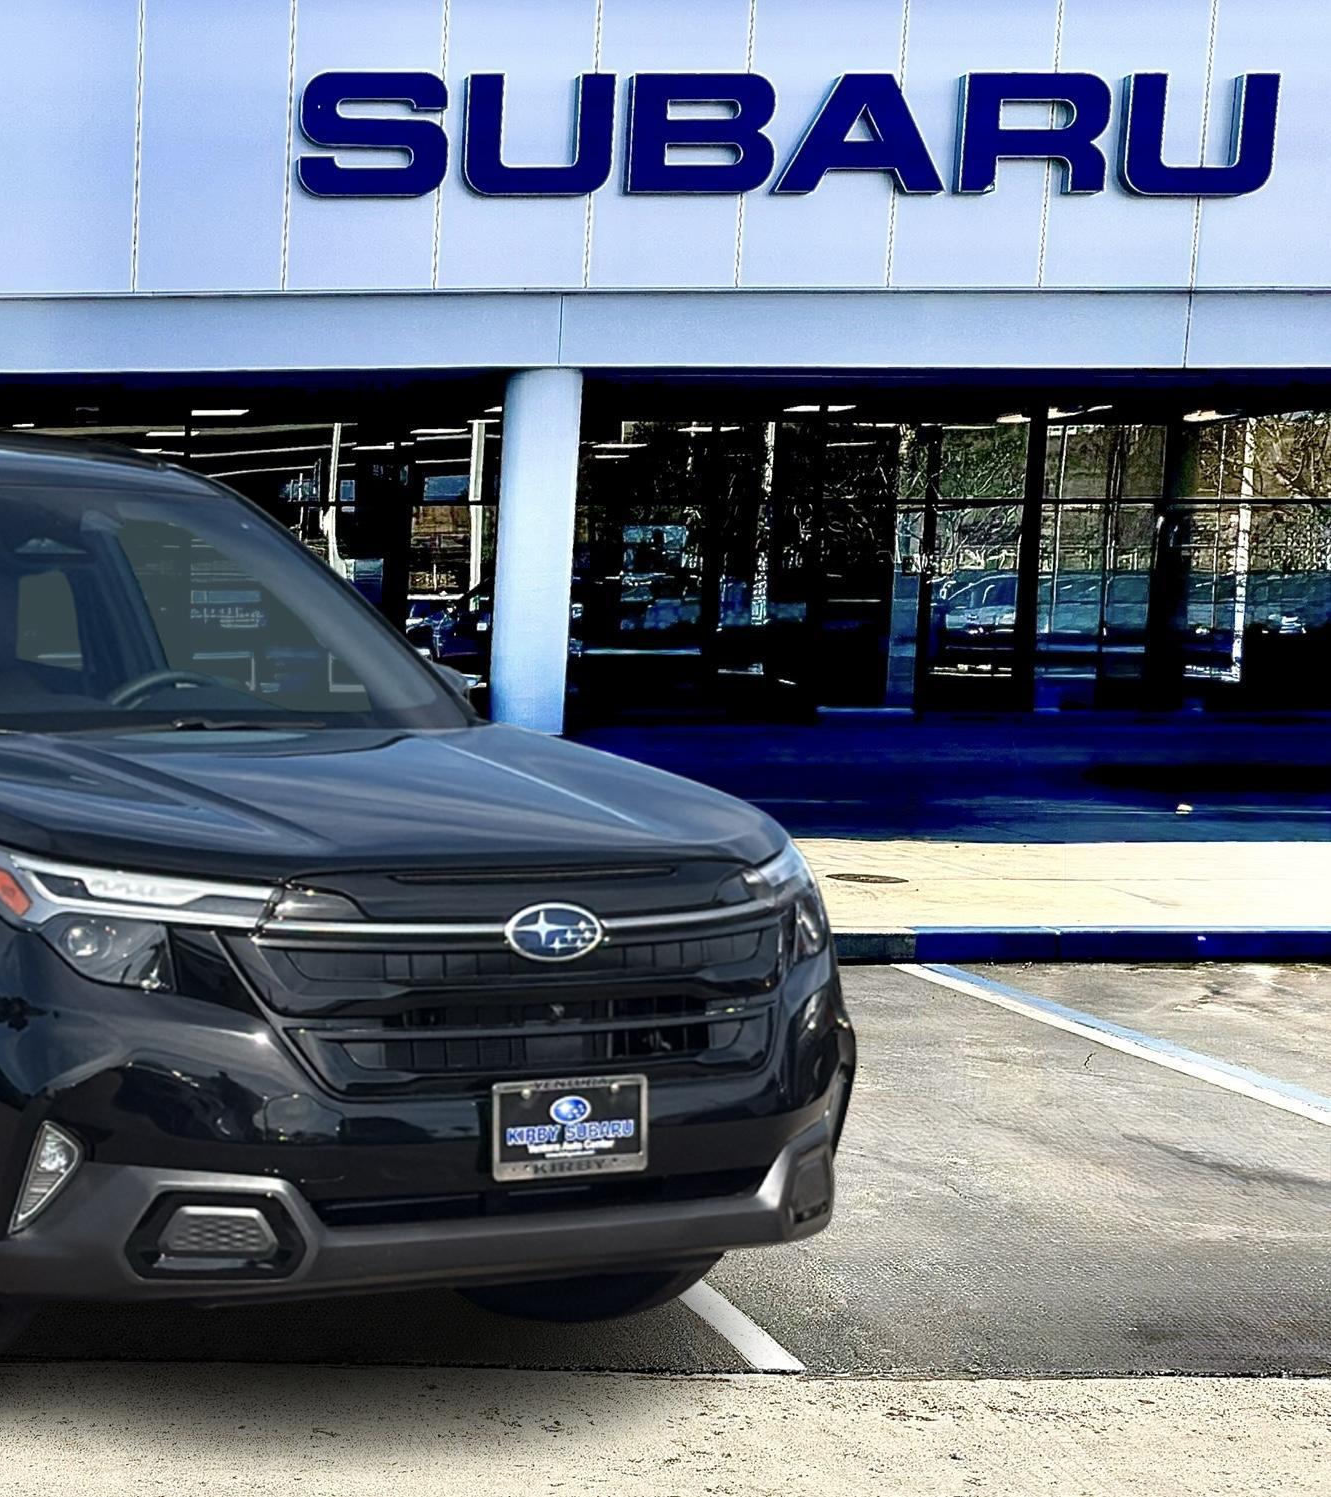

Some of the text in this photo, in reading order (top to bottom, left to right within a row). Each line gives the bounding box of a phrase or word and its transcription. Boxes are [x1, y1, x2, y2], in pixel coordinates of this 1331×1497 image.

[295, 70, 1282, 198] SUBARU
[506, 1120, 634, 1145] KIRBY SUBARU
[533, 1160, 605, 1174] KIRBY
